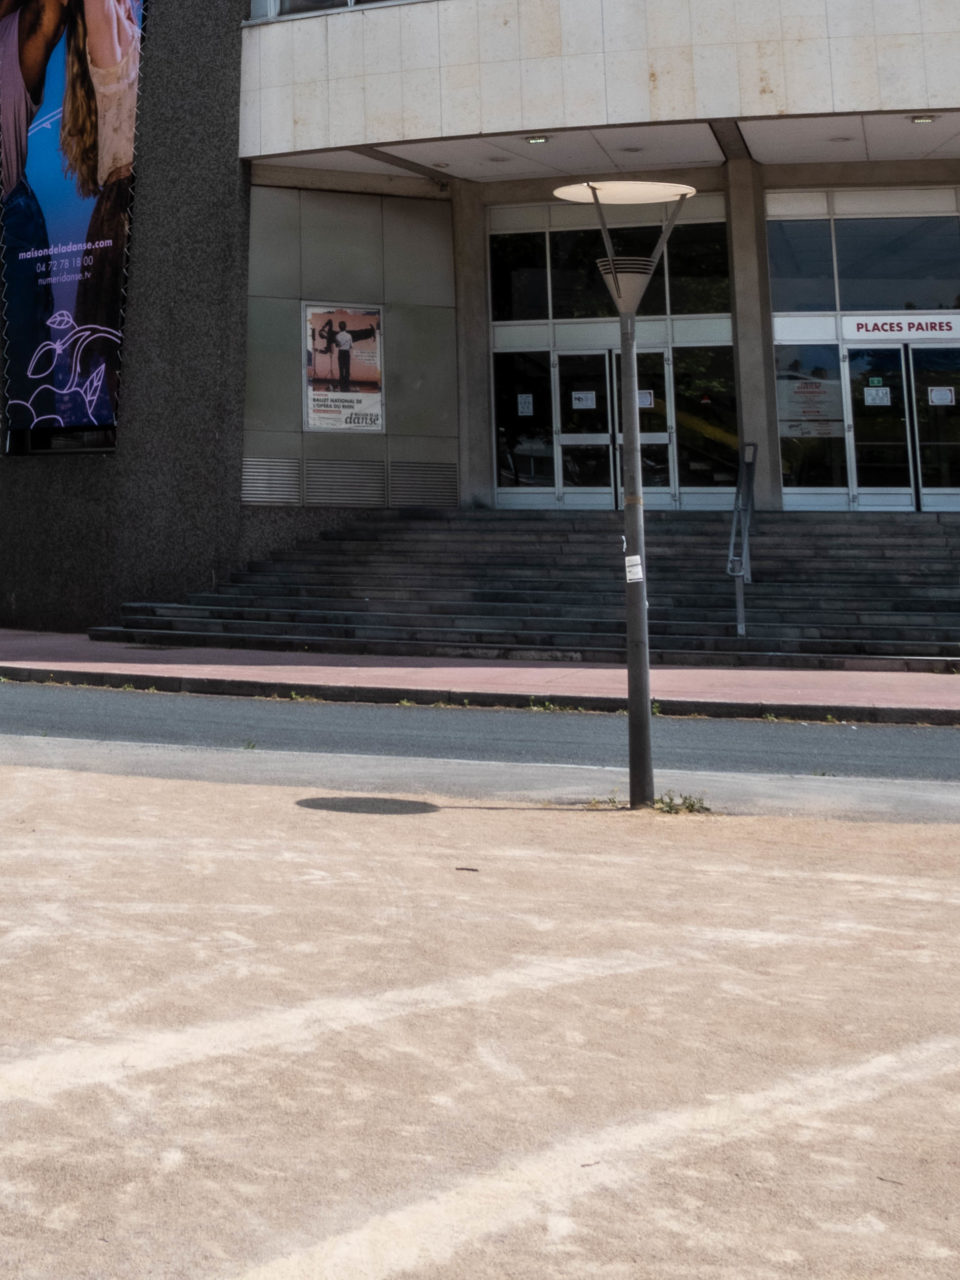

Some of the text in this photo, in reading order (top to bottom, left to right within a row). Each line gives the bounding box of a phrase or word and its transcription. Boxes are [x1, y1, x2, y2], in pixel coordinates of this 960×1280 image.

[18, 239, 113, 259] maisondeladanse.com
[36, 262, 46, 273] 04
[48, 261, 58, 271] 72
[83, 255, 94, 267] 00
[38, 271, 92, 285] numeridanse.tv
[856, 321, 953, 333] PLACES PAIRES
[344, 412, 379, 425] danse
